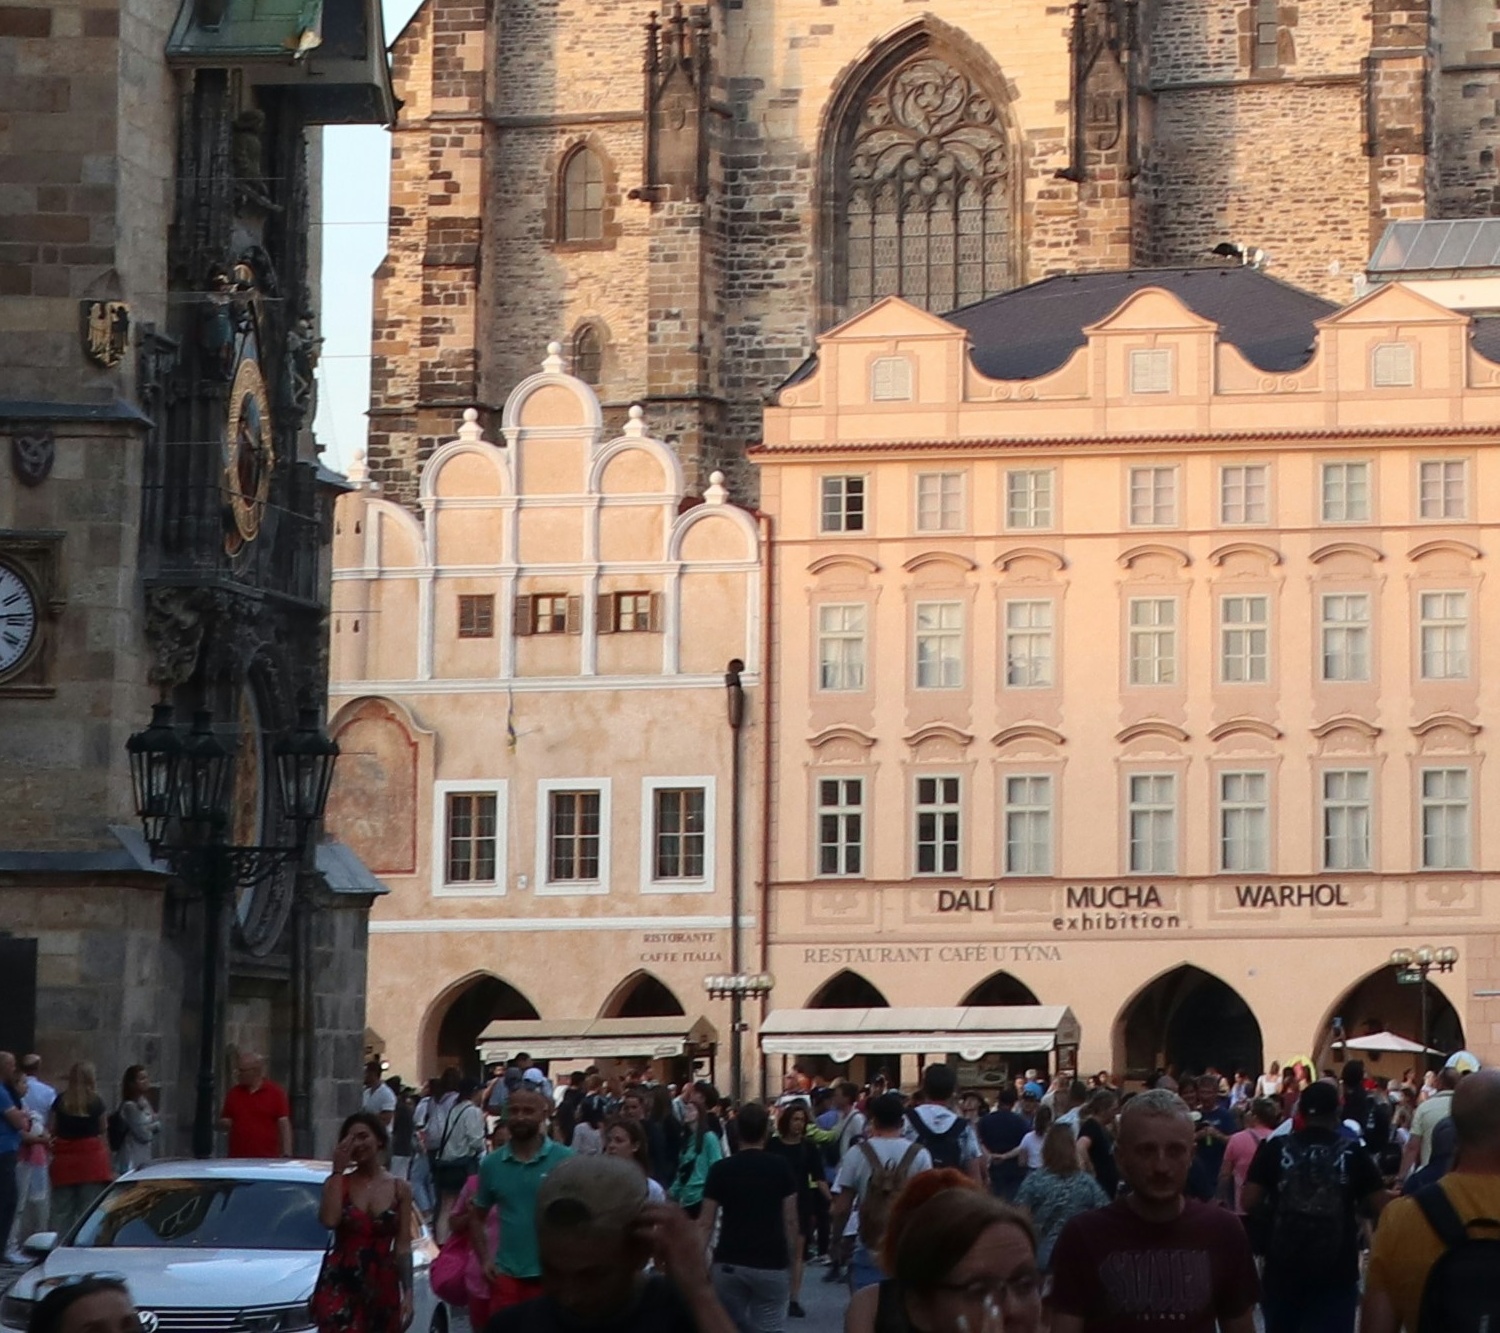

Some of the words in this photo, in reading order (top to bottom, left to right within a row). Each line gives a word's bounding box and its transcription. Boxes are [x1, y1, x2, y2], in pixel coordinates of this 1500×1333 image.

[937, 884, 995, 912] DALÍ
[1067, 885, 1162, 909] MUCHA
[1235, 883, 1348, 908] WARHOL
[1052, 912, 1180, 931] exhibition
[643, 933, 715, 943] RISTORANTE
[682, 952, 722, 962] ITALIA
[803, 947, 933, 963] RESTAURANT
[939, 944, 986, 962] CAFÉ
[993, 946, 1009, 961] U
[1010, 944, 1062, 961] TÝNA
